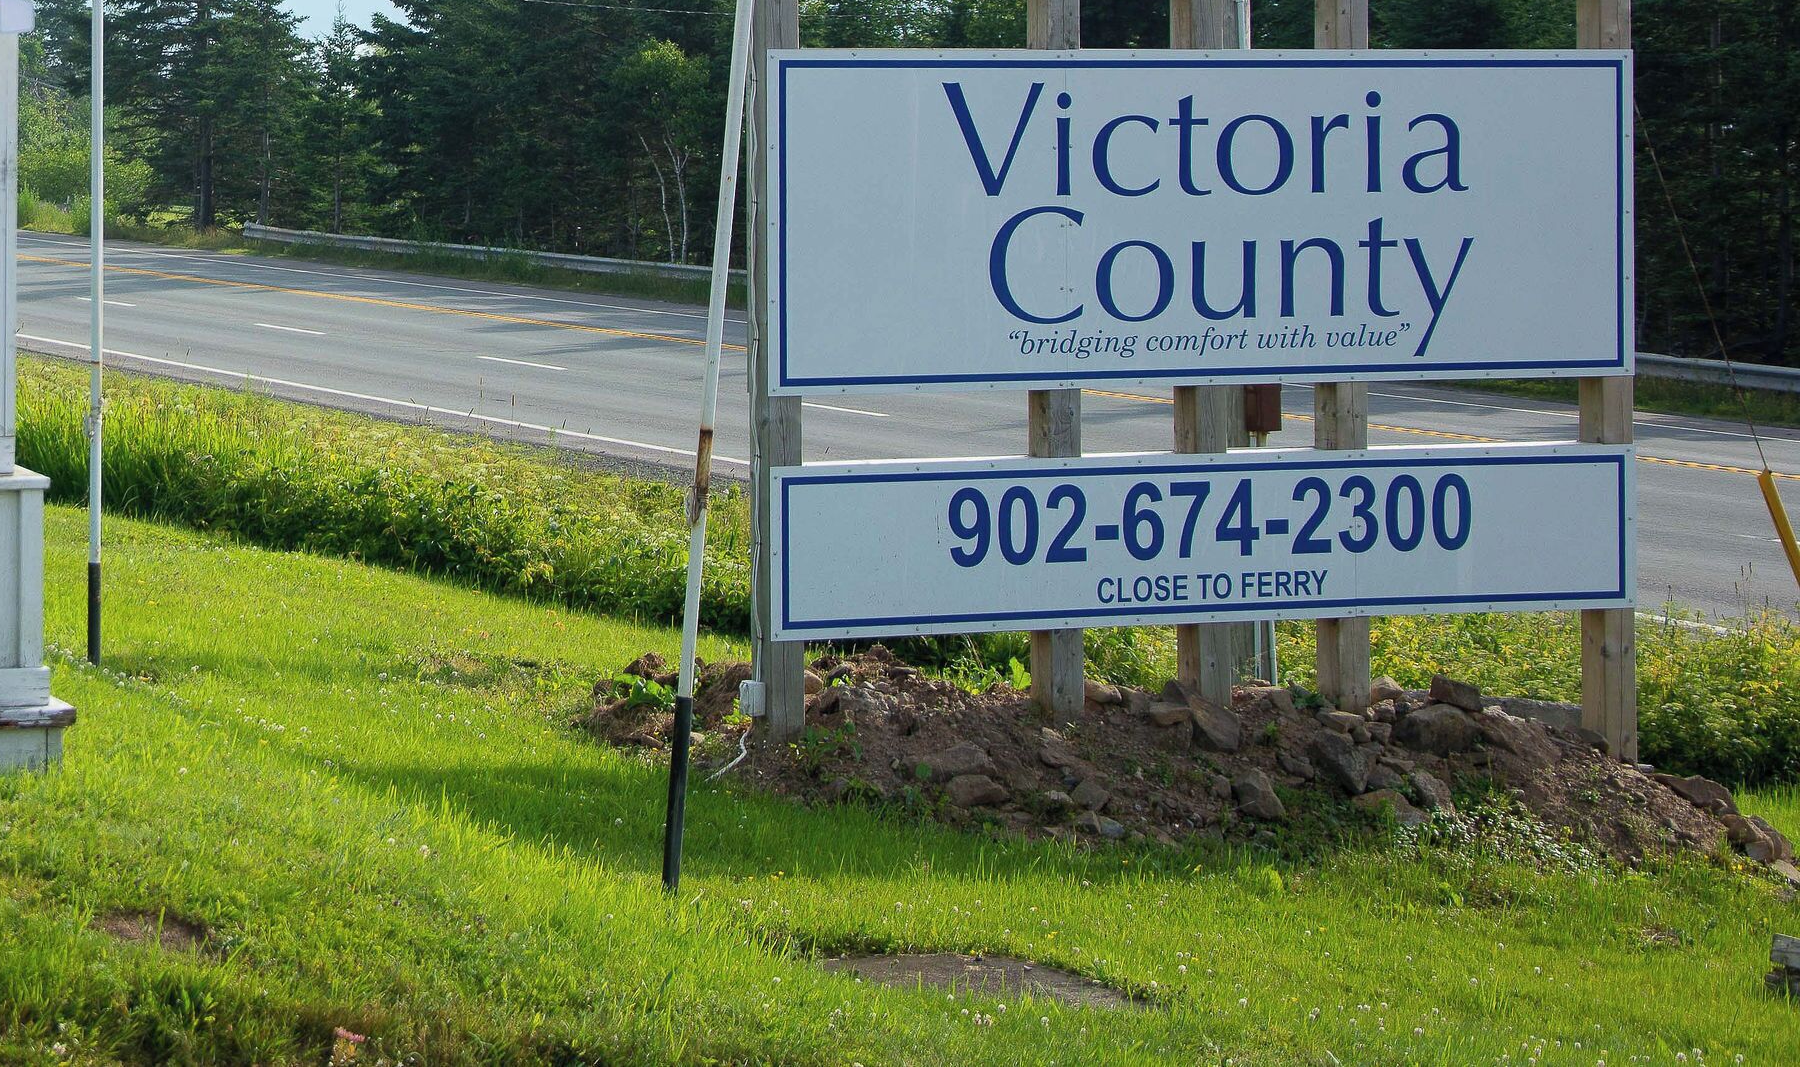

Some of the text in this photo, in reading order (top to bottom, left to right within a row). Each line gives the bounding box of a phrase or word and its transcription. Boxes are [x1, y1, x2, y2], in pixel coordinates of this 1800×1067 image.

[941, 81, 1470, 197] Victoria
[989, 205, 1475, 358] County
[1145, 326, 1249, 357] comfort
[1257, 323, 1318, 350] with
[948, 473, 1472, 568] 902-674-2300
[1097, 569, 1329, 604] CLOSE TO FERRY
